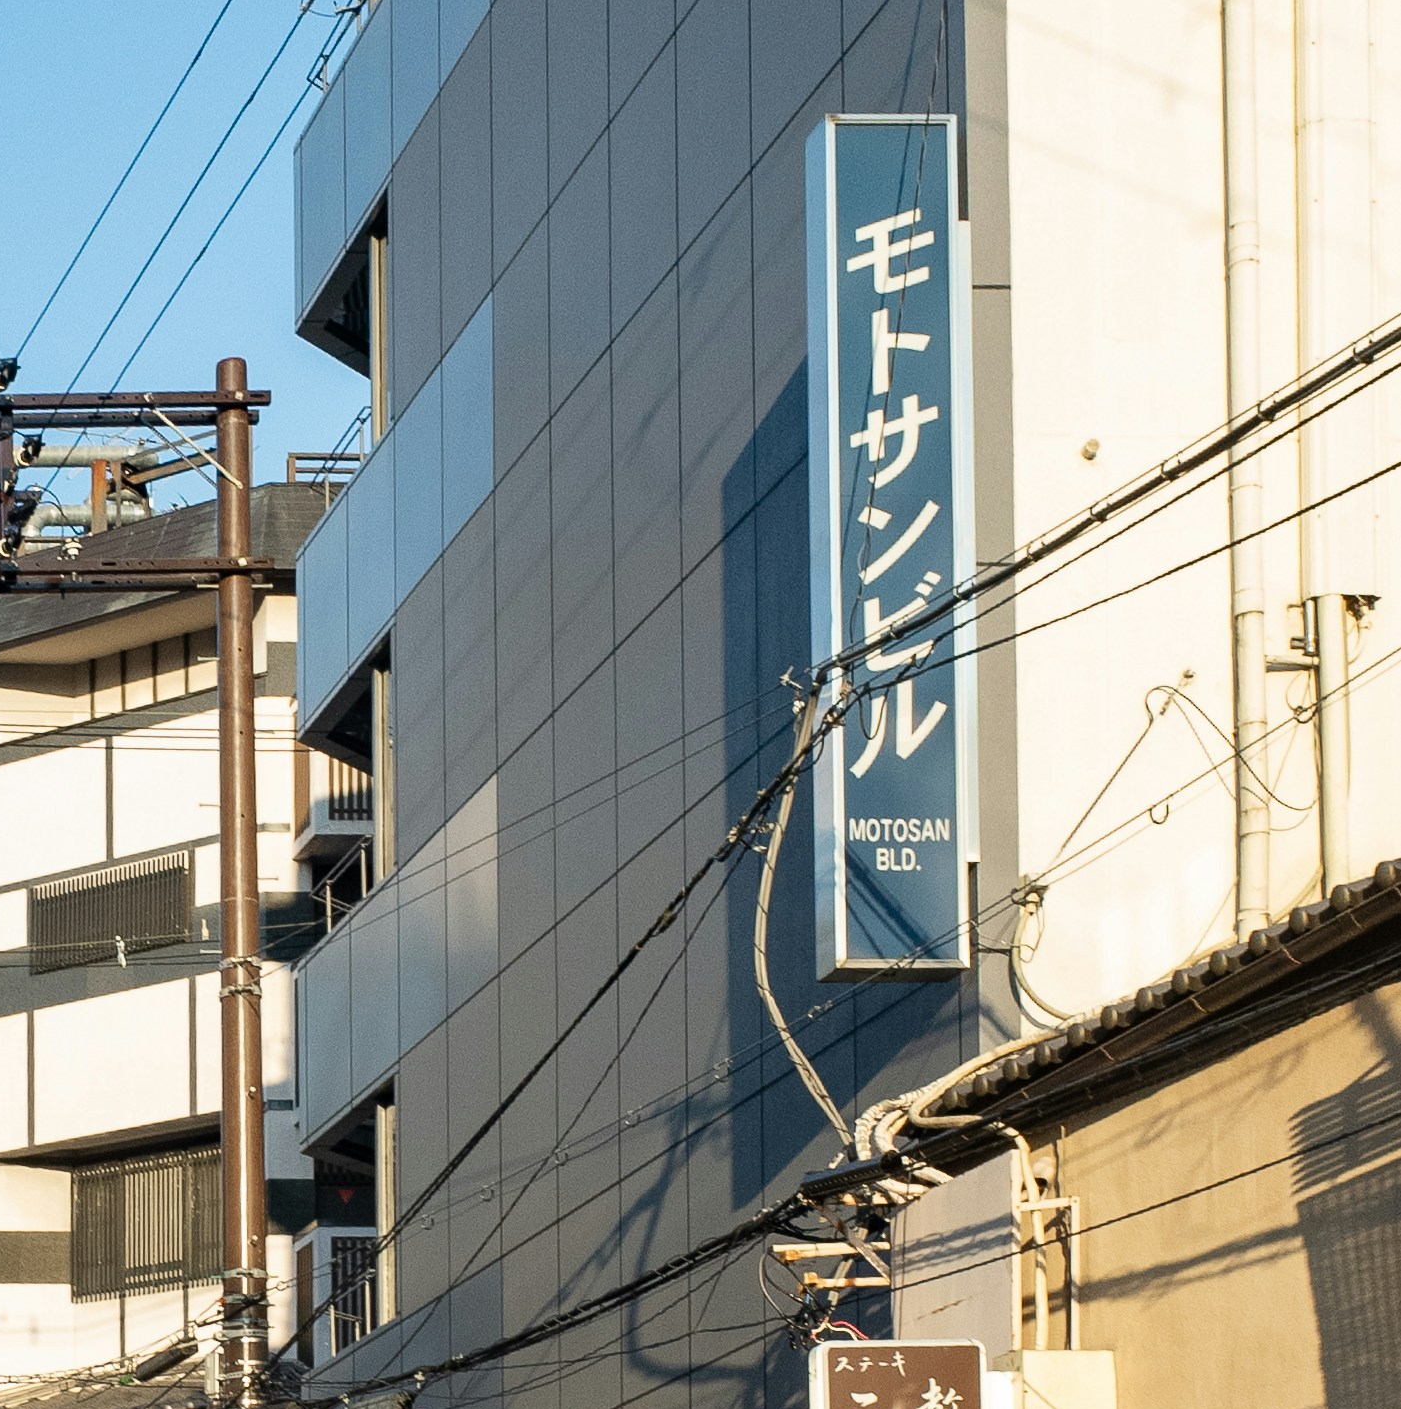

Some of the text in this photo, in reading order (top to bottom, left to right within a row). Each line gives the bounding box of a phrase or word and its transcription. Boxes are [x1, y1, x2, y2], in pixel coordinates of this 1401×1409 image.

[846, 207, 948, 779] モトサンビル
[848, 817, 951, 843] MOTOSAN
[875, 847, 922, 872] BLD.
[834, 1350, 906, 1378] ステーキ
